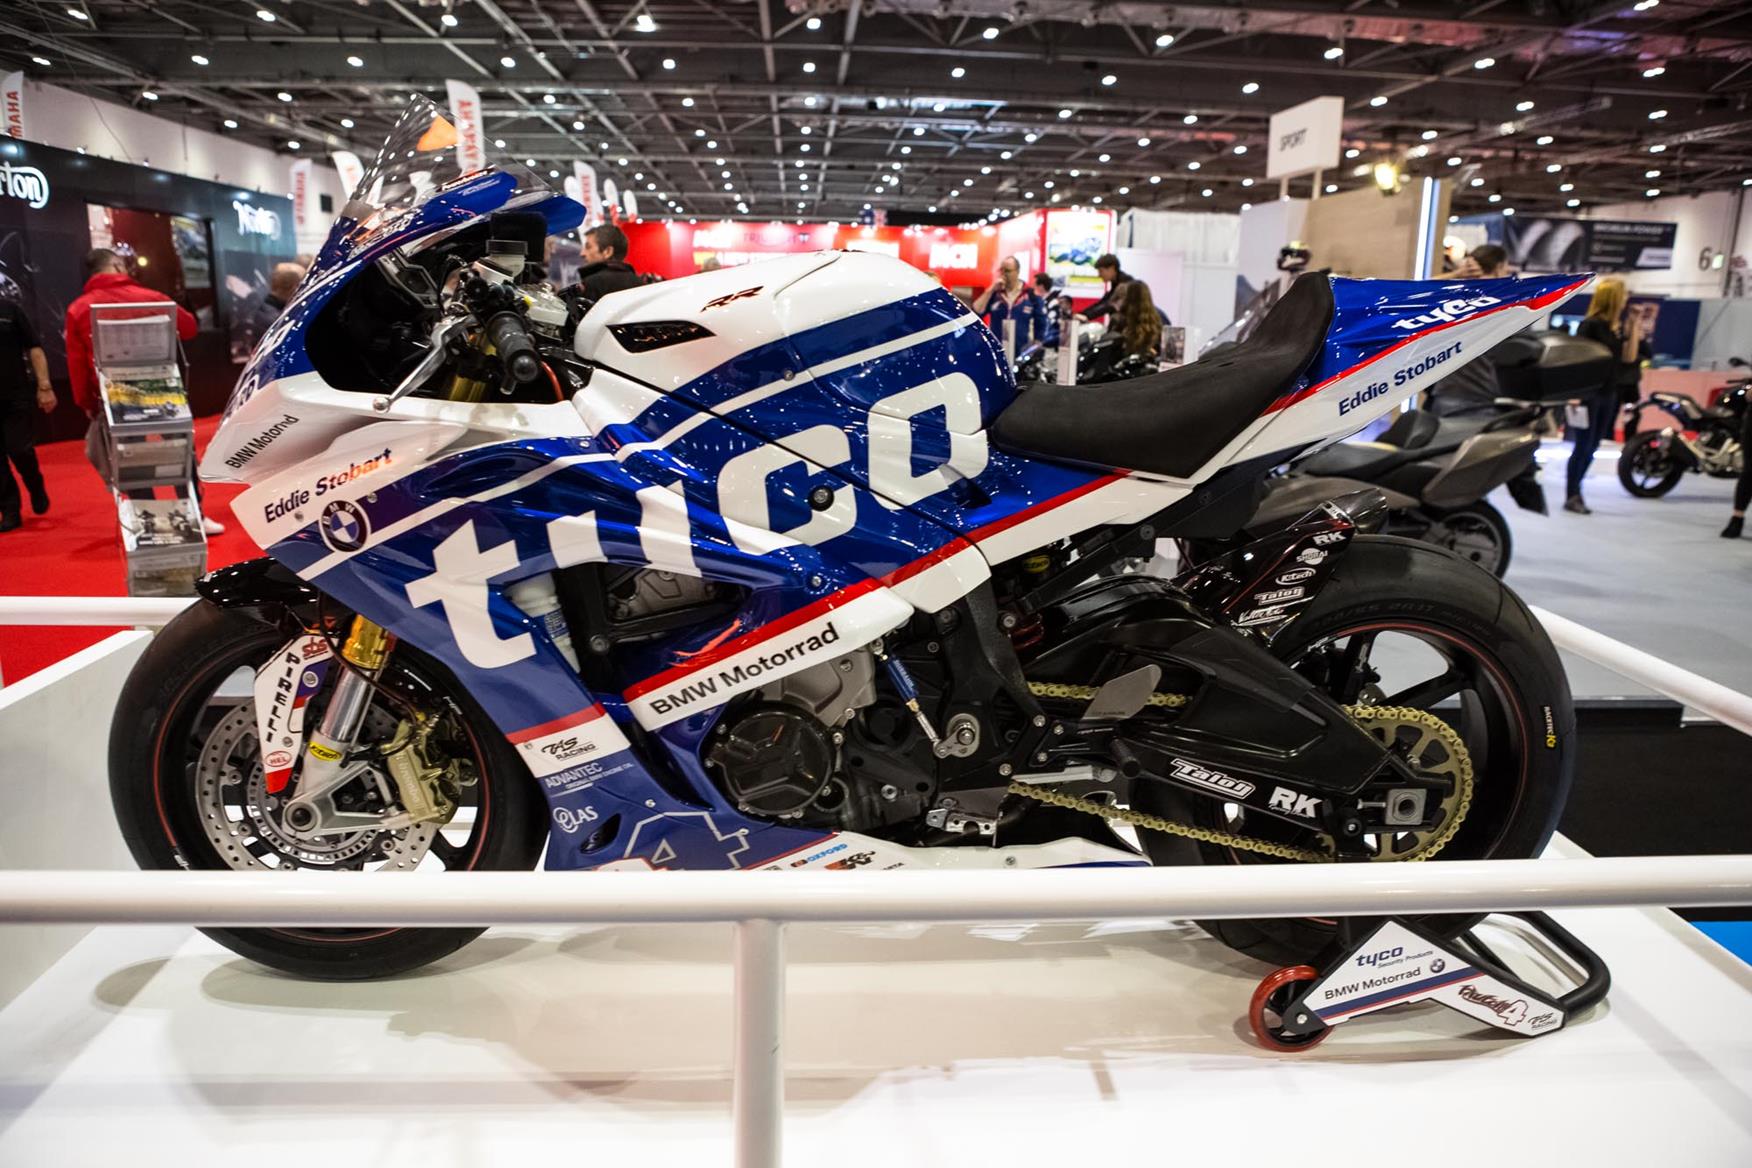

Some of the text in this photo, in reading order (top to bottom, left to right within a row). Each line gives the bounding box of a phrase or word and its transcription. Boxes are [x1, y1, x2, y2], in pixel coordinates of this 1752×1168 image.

[7, 91, 23, 138] MAHA
[0, 161, 49, 209] rton
[1391, 296, 1502, 330] tyco
[1339, 341, 1463, 416] Eddie Stobart
[225, 441, 257, 469] BMW
[264, 448, 393, 523] Eddie Stobart
[404, 372, 988, 669] tyco
[1313, 531, 1347, 546] RK
[302, 637, 328, 658] sbs
[649, 678, 718, 714] BMW
[719, 621, 840, 687] Motorrad
[265, 652, 301, 743] PIRELLI
[556, 743, 597, 760] RACING
[544, 762, 603, 788] ADVANTEC
[1269, 786, 1323, 818] RK
[807, 843, 848, 862] OXFORD
[1356, 946, 1404, 966] tyco
[1325, 967, 1422, 1000] BMW Motorrad
